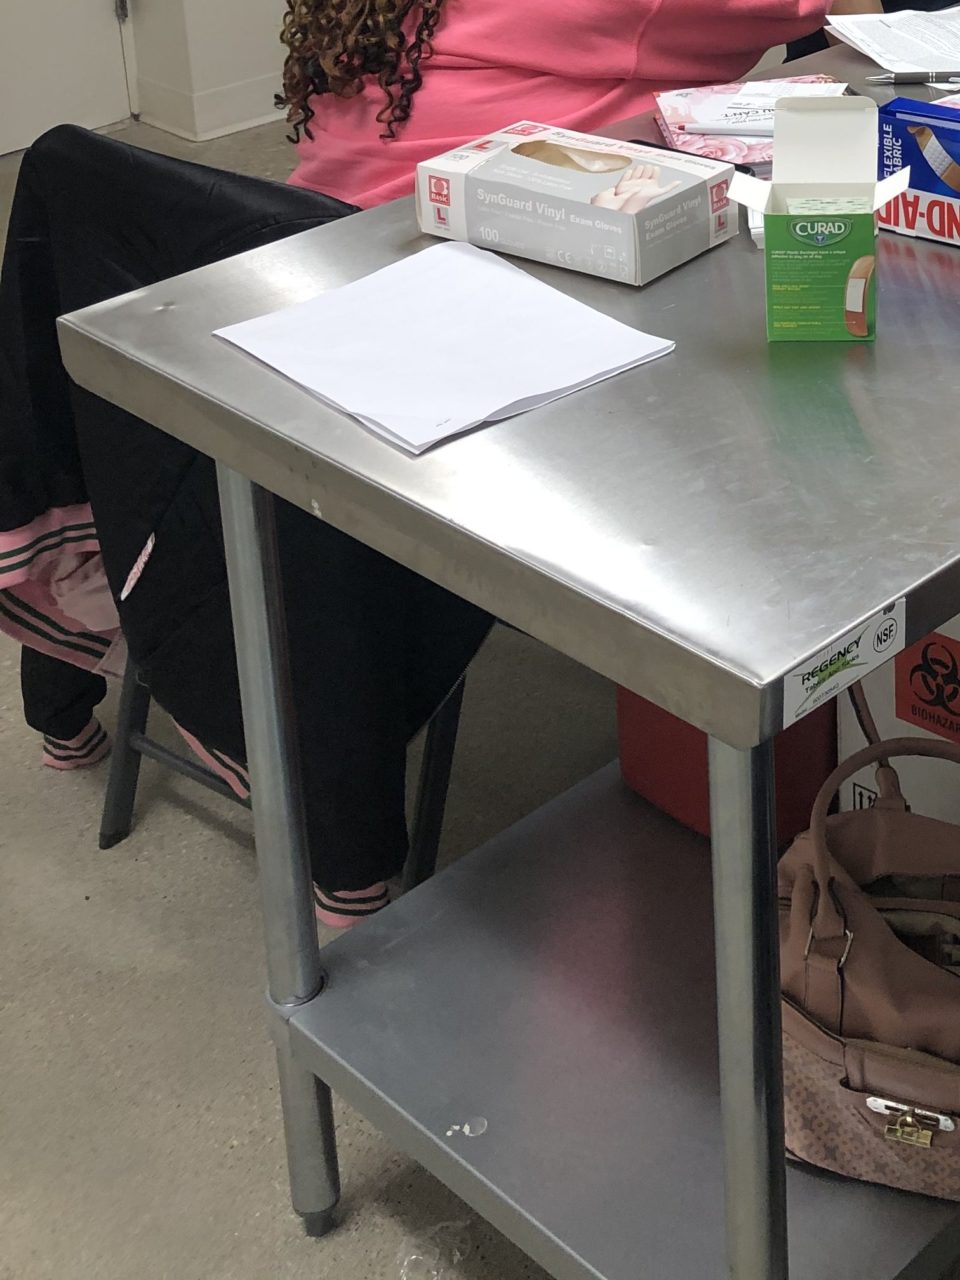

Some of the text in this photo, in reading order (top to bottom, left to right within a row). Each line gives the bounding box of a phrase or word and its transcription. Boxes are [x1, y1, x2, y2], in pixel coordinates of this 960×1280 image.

[883, 124, 892, 179] FLEXIBLE
[892, 138, 902, 173] ABRIC
[436, 207, 446, 221] L
[476, 188, 533, 212] SynGuard
[535, 201, 566, 221] Vinyl
[569, 214, 593, 227] Exam
[594, 219, 622, 234] Gloves
[717, 214, 725, 228] L
[479, 226, 500, 242] 100
[795, 222, 845, 236] CURAD
[801, 623, 894, 686] REGENCY NSF
